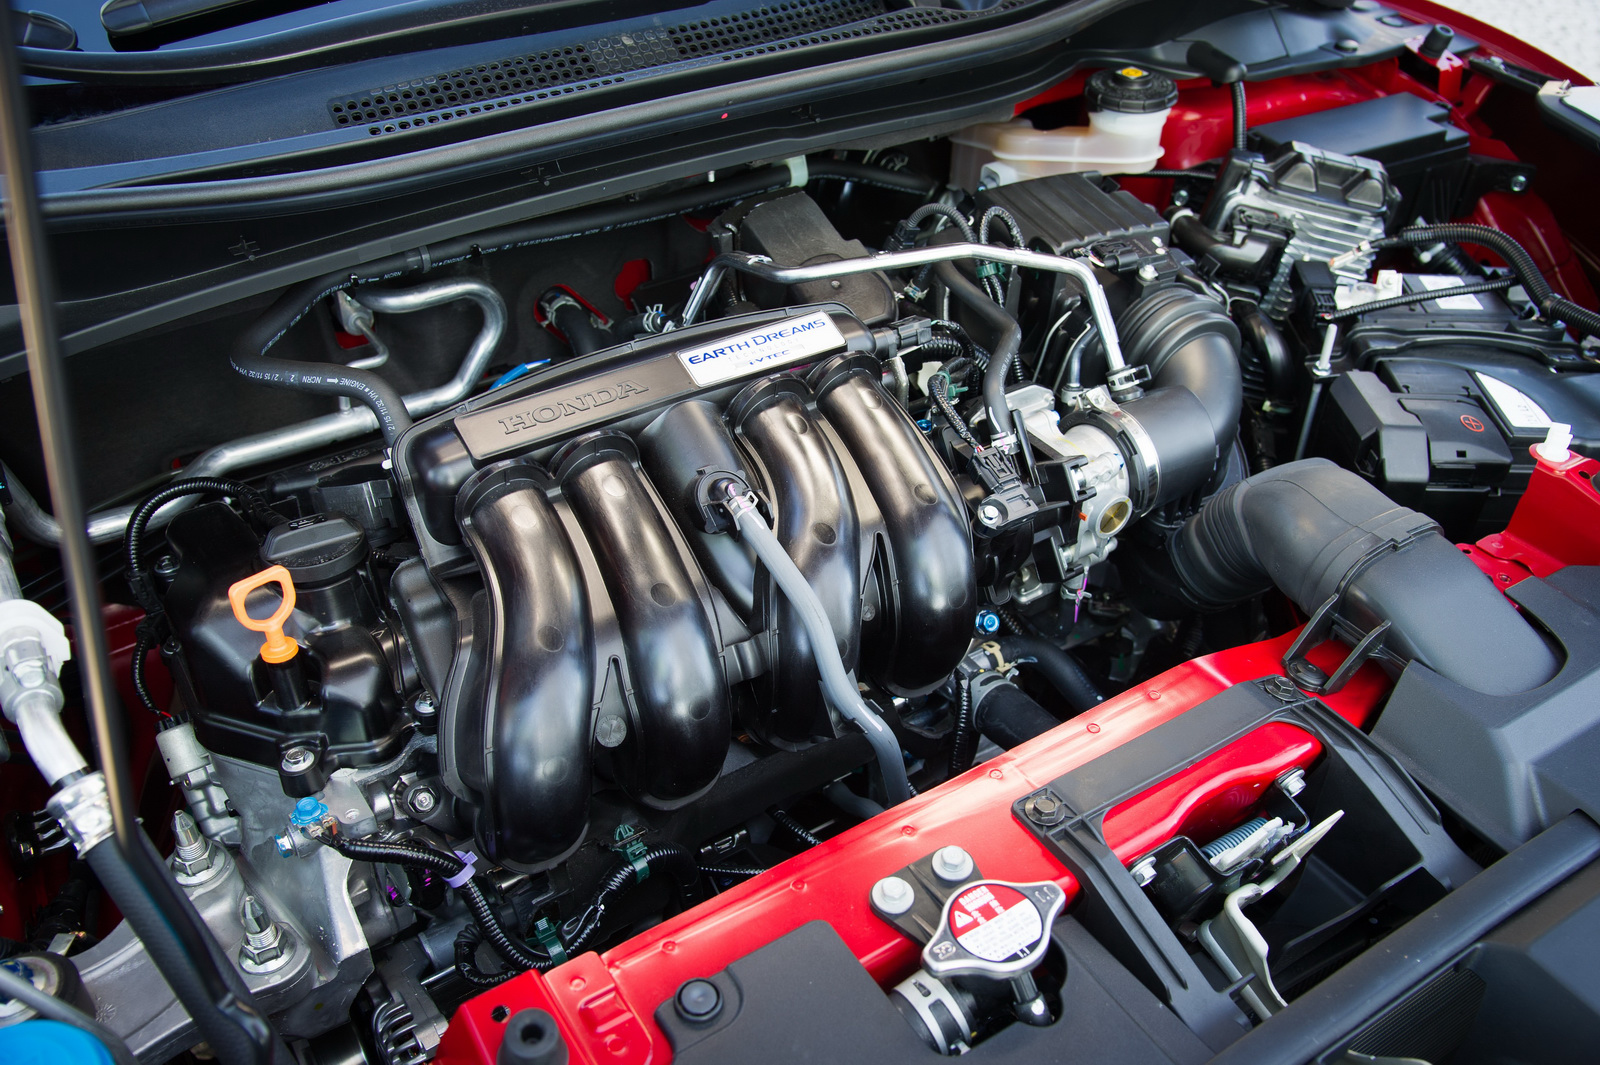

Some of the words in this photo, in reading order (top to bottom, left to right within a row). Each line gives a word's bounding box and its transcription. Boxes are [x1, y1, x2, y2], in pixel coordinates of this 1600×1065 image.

[688, 341, 750, 365] EARTH
[751, 318, 826, 346] DREAMS
[301, 375, 322, 384] NCRN
[339, 377, 366, 391] ENGINE
[498, 380, 650, 435] HONDA
